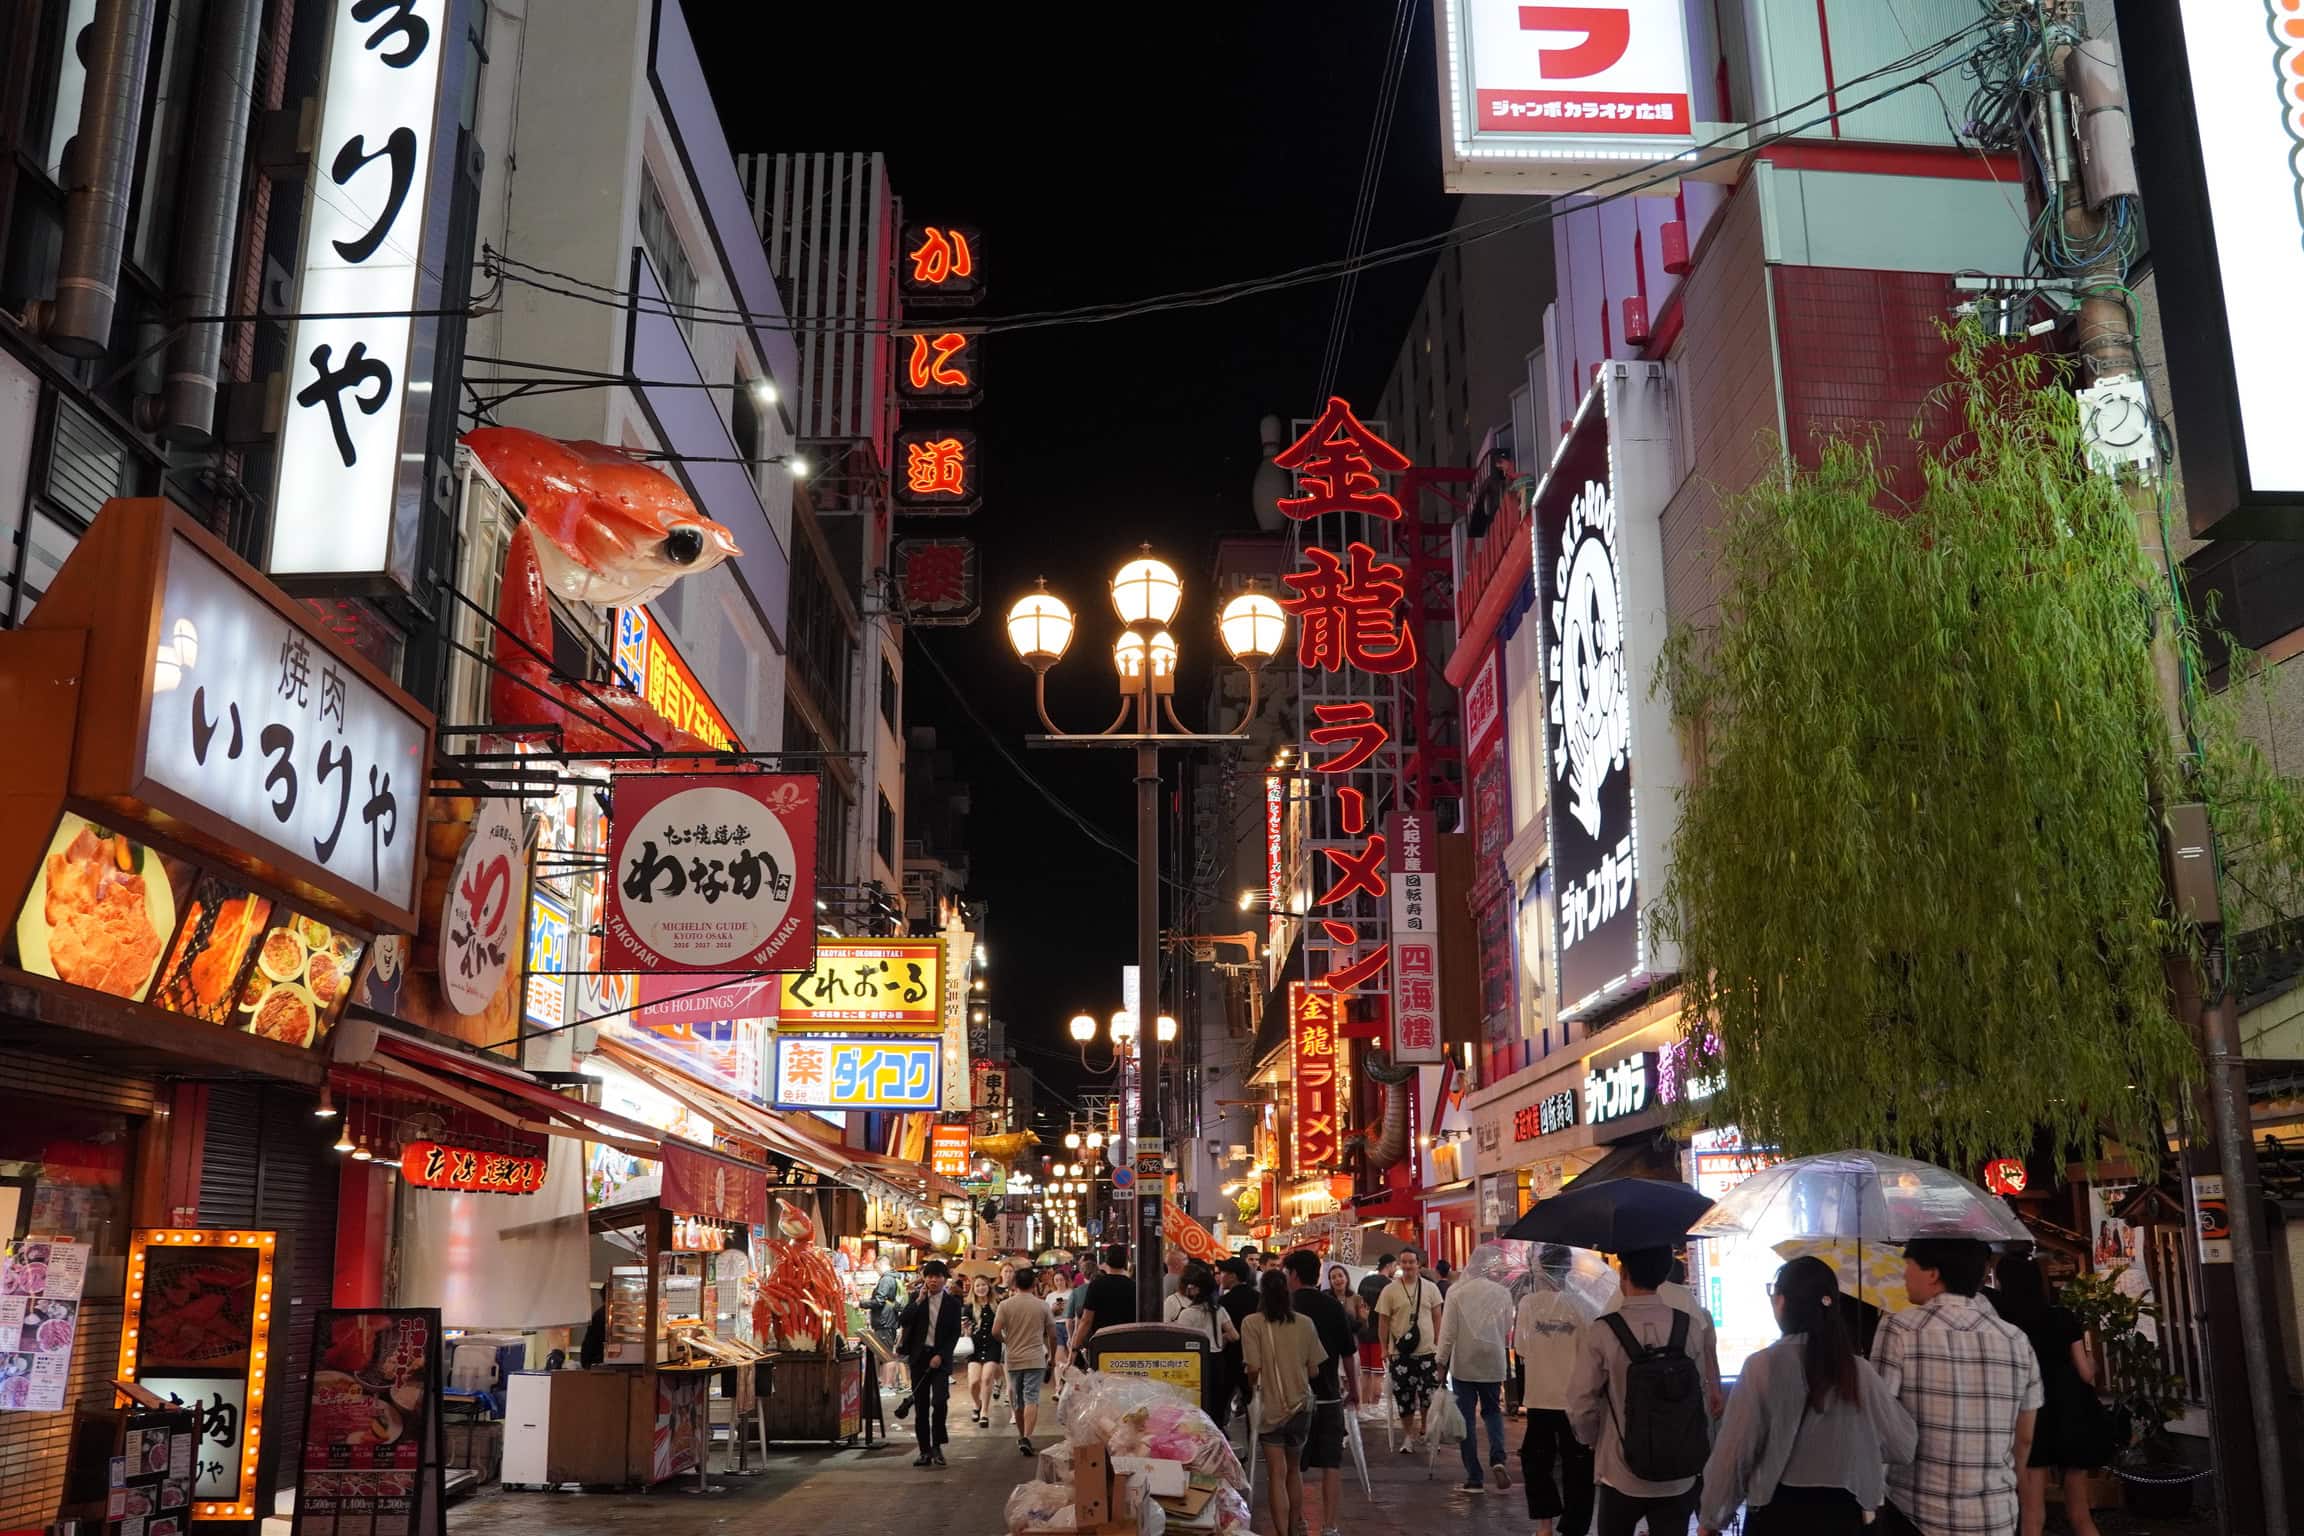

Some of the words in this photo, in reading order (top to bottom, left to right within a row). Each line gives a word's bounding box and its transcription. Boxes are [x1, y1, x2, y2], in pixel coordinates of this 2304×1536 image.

[277, 629, 347, 734] 焼肉
[1273, 396, 1418, 993] 金龍ラーメン
[192, 686, 397, 891] いろりや
[663, 824, 751, 846] たこ焼道楽
[1403, 816, 1421, 871] 大起水産
[623, 841, 780, 904] わなか
[1561, 835, 1633, 951] ジャンカラ
[662, 922, 712, 931] MICHELIN
[716, 922, 748, 931] GUIDE
[1406, 875, 1423, 930] 回転寿司
[609, 915, 660, 968] TAKOYAKI
[753, 916, 800, 965] WANAKA
[671, 995, 734, 1013] HOLDINGS
[788, 1043, 824, 1085] 薬
[834, 1049, 931, 1099] ダイコク
[1299, 993, 1334, 1167] 金龍ラーメン
[1584, 1052, 1646, 1125] ジャンカラ
